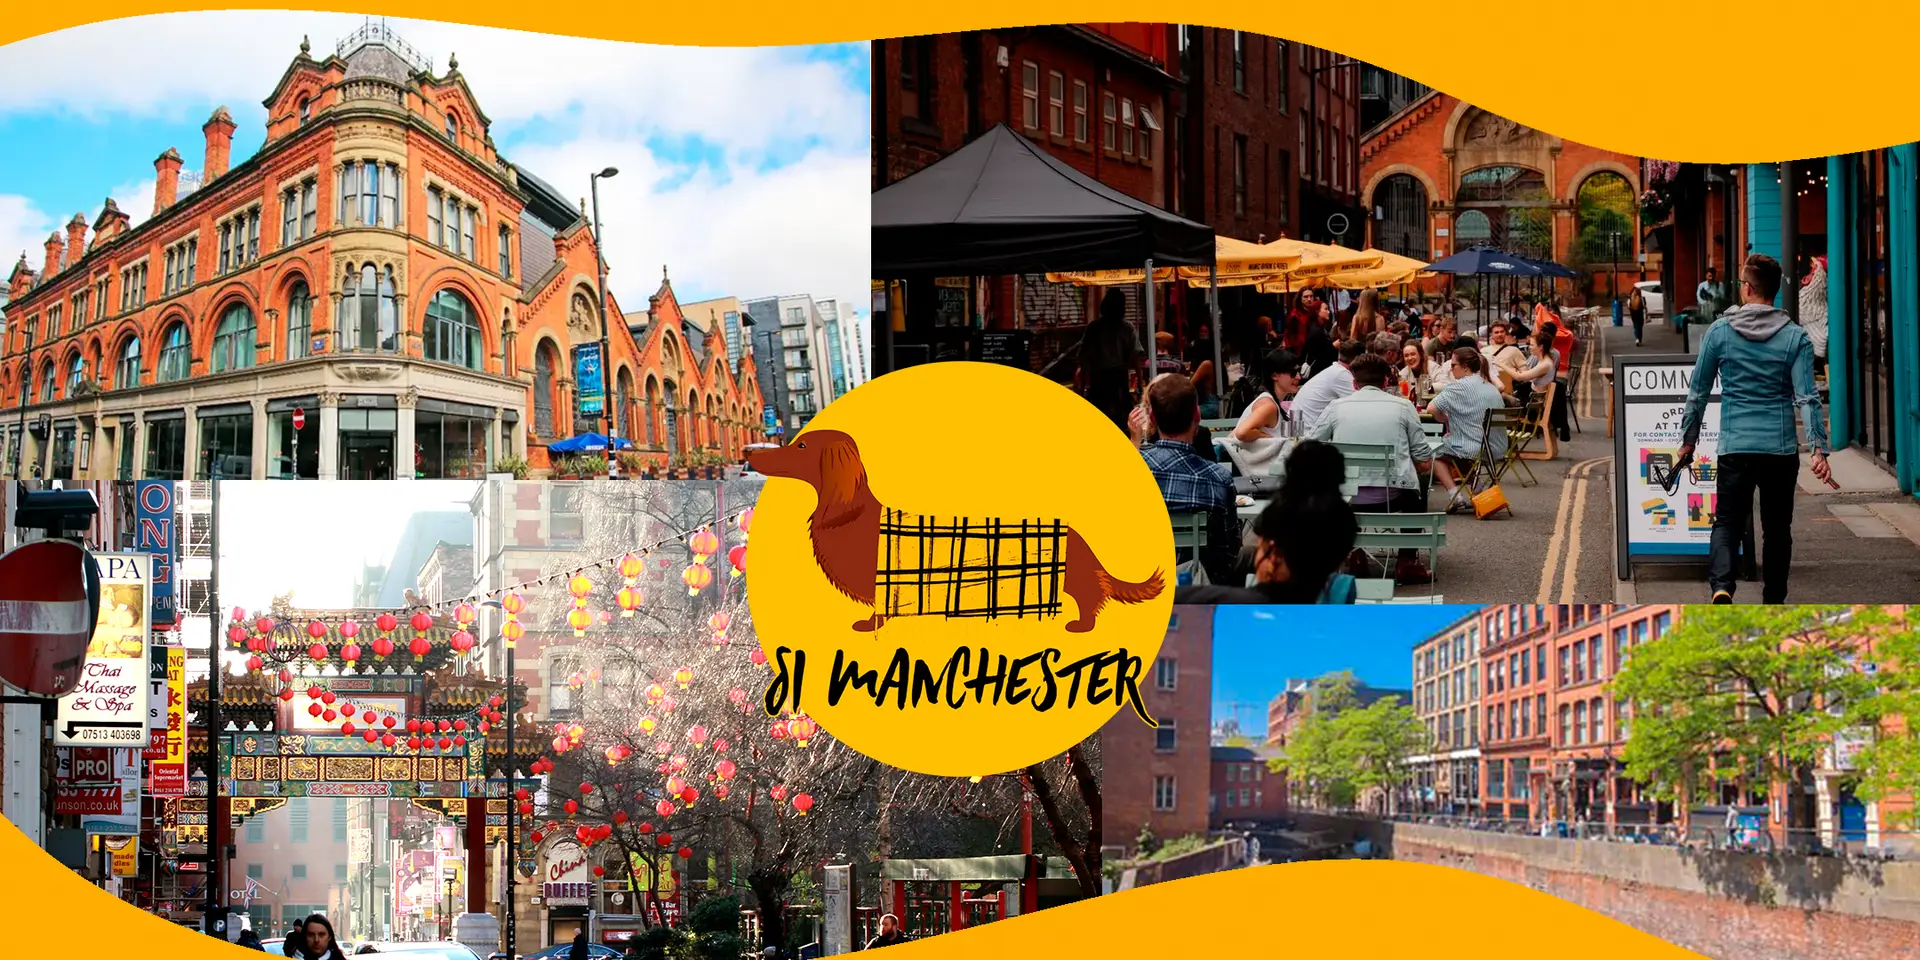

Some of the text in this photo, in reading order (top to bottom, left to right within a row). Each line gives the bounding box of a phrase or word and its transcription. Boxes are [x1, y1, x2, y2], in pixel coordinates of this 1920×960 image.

[1629, 369, 1722, 391] COMM
[1662, 407, 1685, 419] ORD
[1655, 422, 1669, 430] AT
[84, 663, 122, 677] Thai
[72, 680, 136, 699] Massage
[71, 697, 134, 715] & Spa
[82, 729, 141, 740] 07513 403698
[150, 735, 166, 745] 97
[77, 760, 107, 776] PRO
[550, 856, 586, 881] China
[230, 889, 262, 900] OTL
[544, 882, 592, 899] BUFFET
